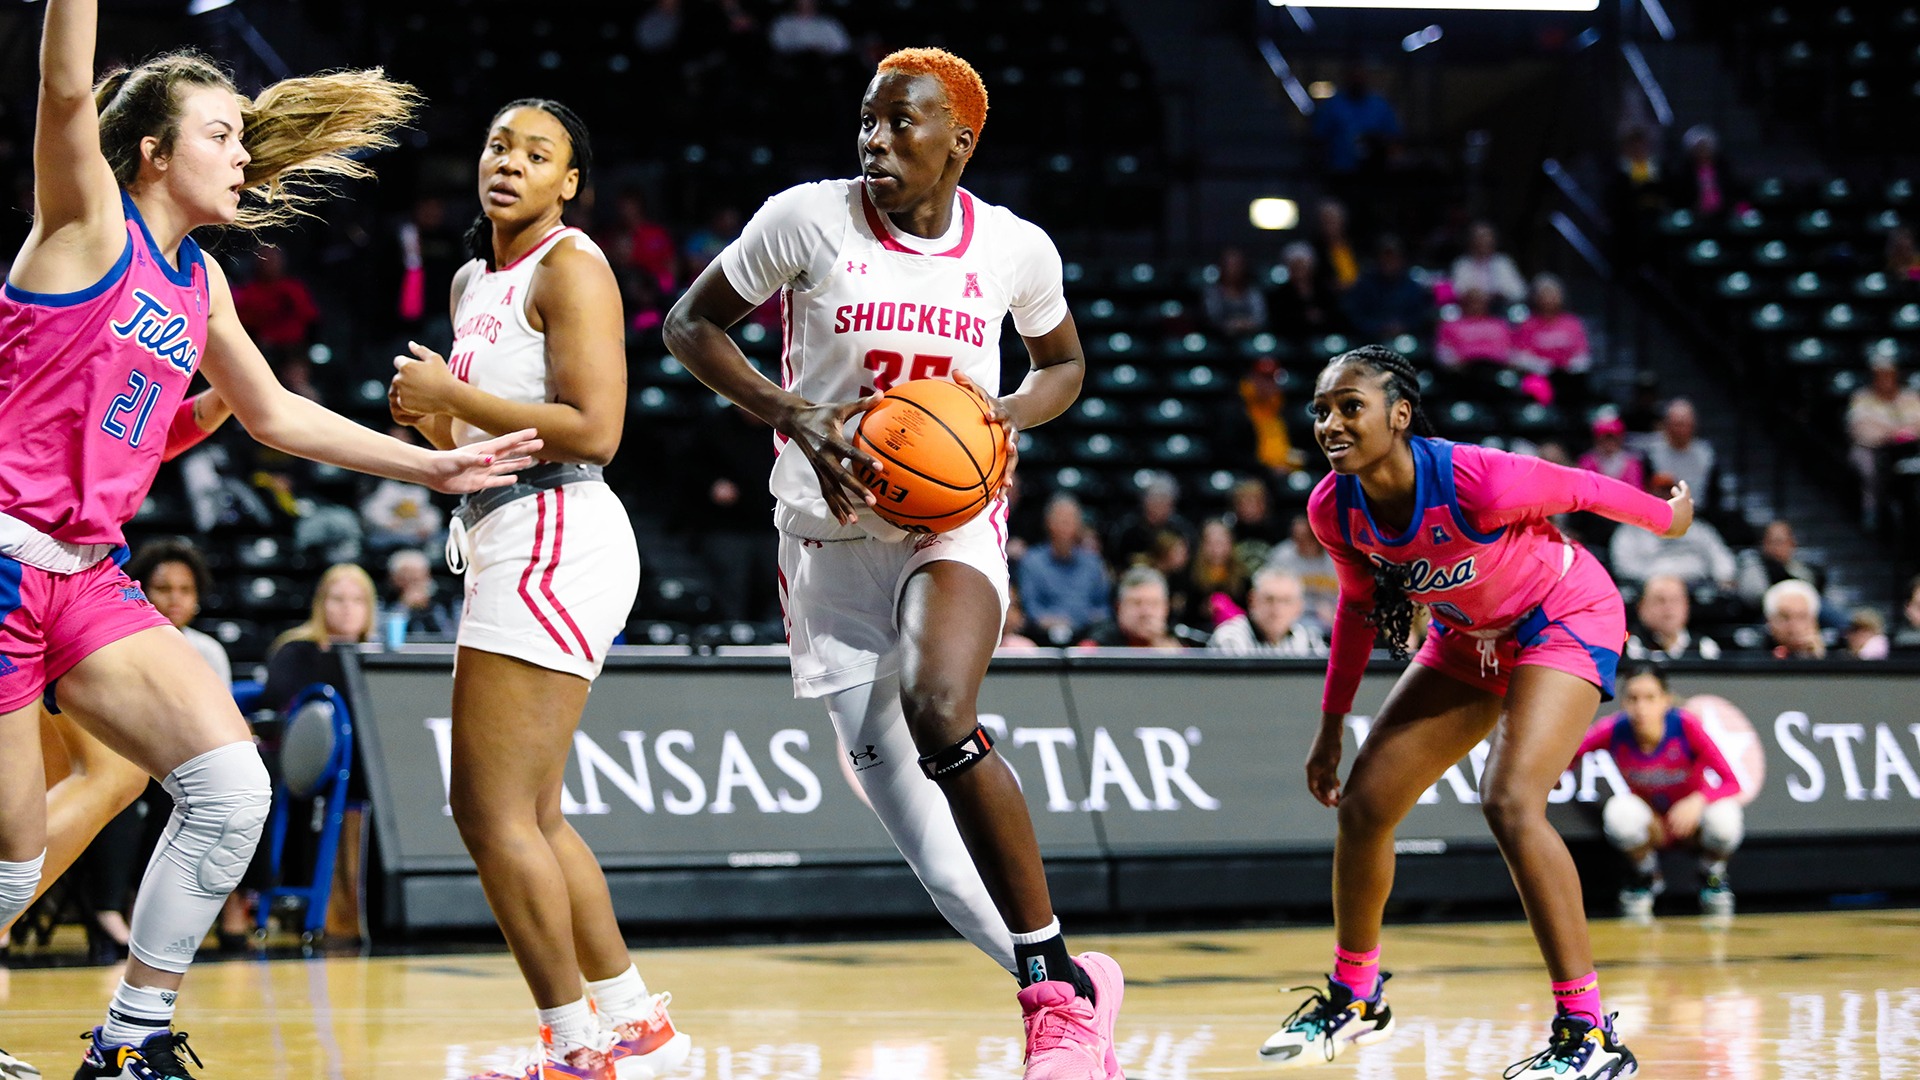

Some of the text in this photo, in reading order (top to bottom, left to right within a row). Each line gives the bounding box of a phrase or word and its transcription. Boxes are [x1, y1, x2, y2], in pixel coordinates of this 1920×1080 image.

[110, 288, 198, 379] Tulsa
[834, 302, 986, 348] SHOCKERS
[101, 368, 162, 449] 21
[1369, 552, 1477, 594] lsa
[424, 717, 823, 816] NSAS
[938, 755, 969, 774] MUELLER
[1774, 710, 1920, 803] STA
